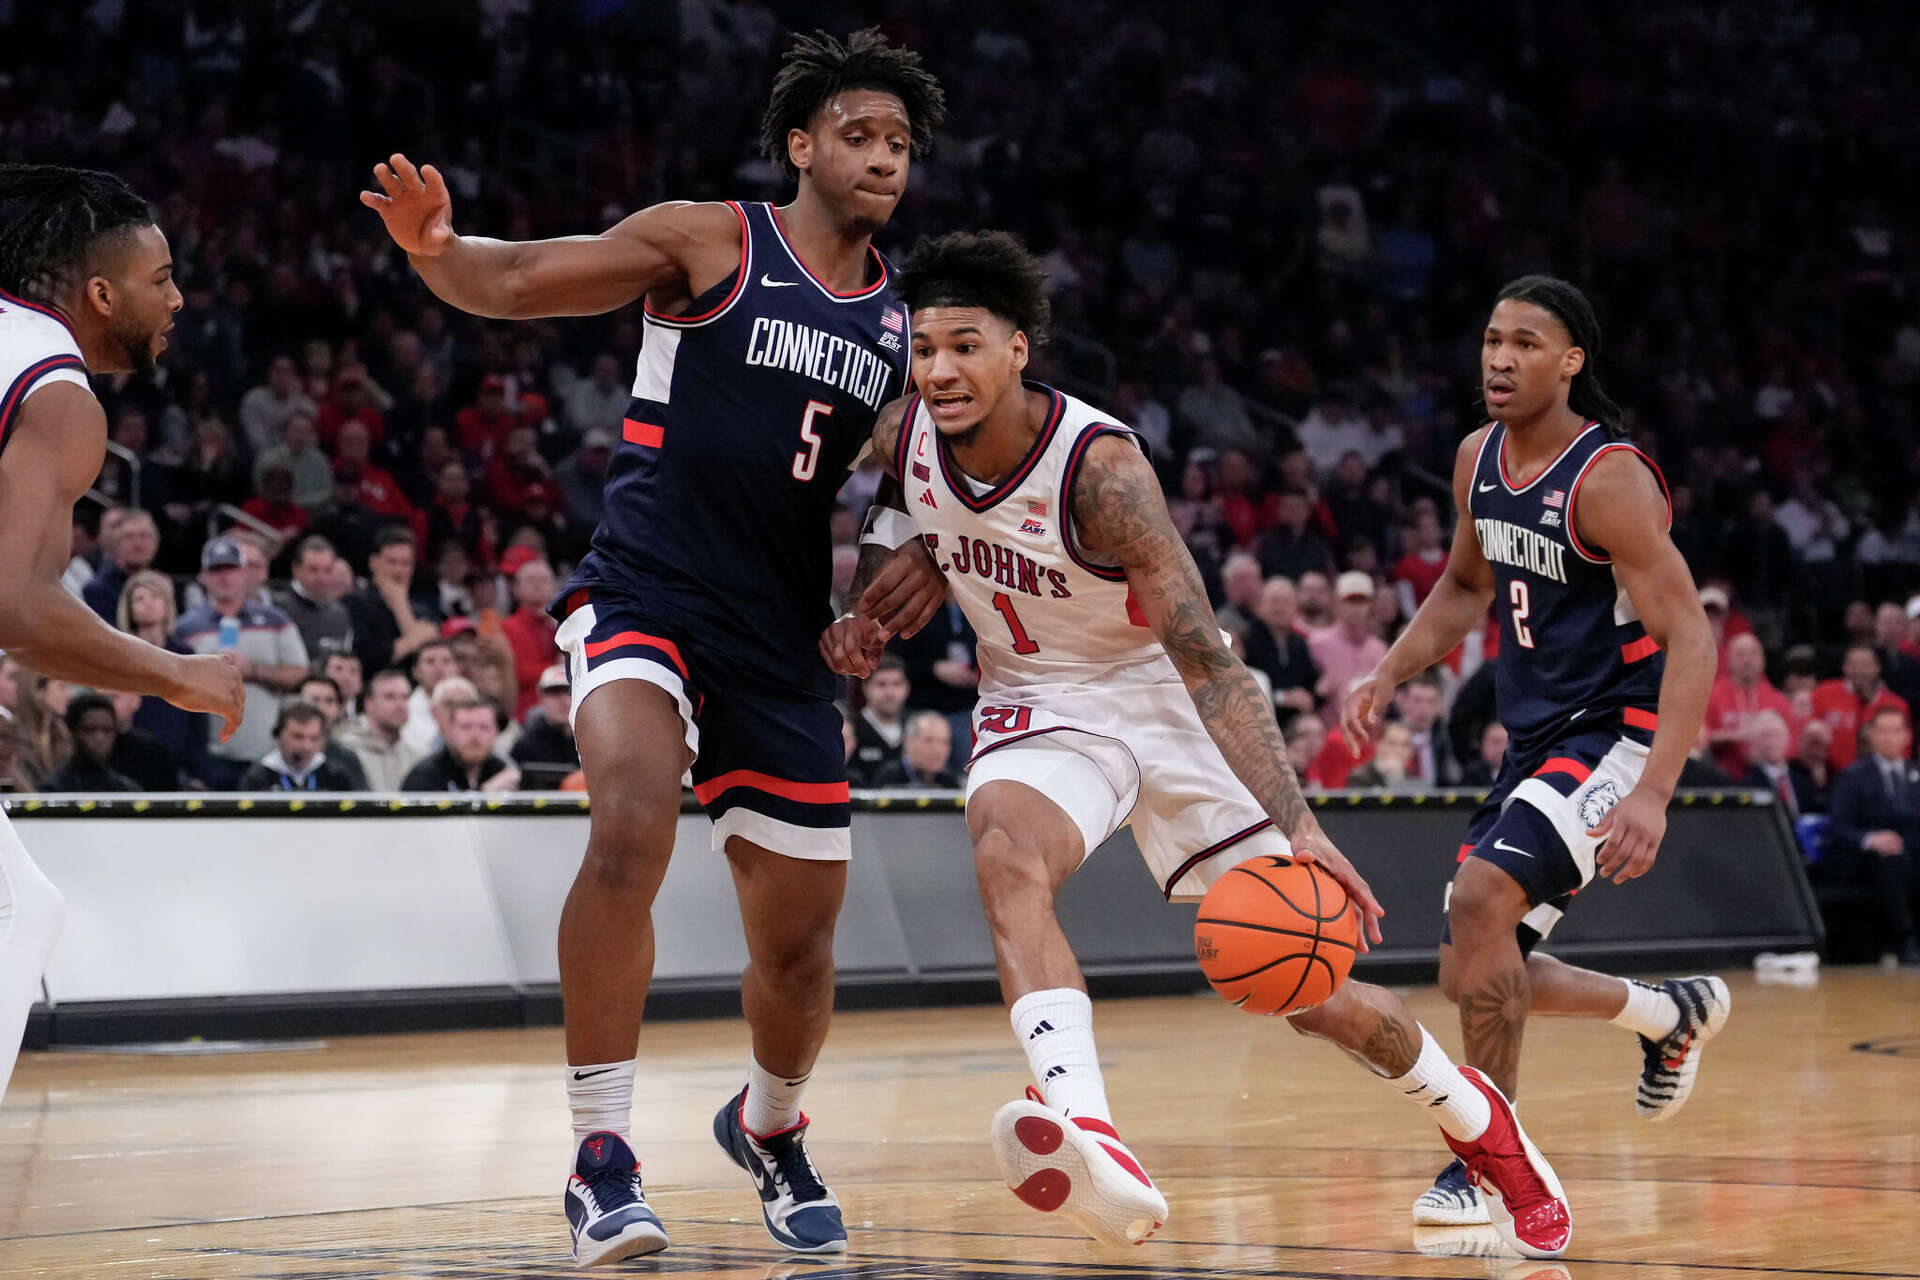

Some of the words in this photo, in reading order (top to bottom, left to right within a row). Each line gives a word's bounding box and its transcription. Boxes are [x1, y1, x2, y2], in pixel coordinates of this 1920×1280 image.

[745, 316, 893, 412] CONNECTICUT
[879, 336, 902, 350] EAST
[883, 331, 899, 342] BIG
[792, 400, 835, 482] 5
[1020, 524, 1047, 535] EAST
[1024, 519, 1042, 528] BIG
[1475, 518, 1567, 584] CONNECTICUT
[951, 535, 1072, 599] JOHN'S
[992, 591, 1041, 655] 1
[1509, 579, 1535, 649] 2
